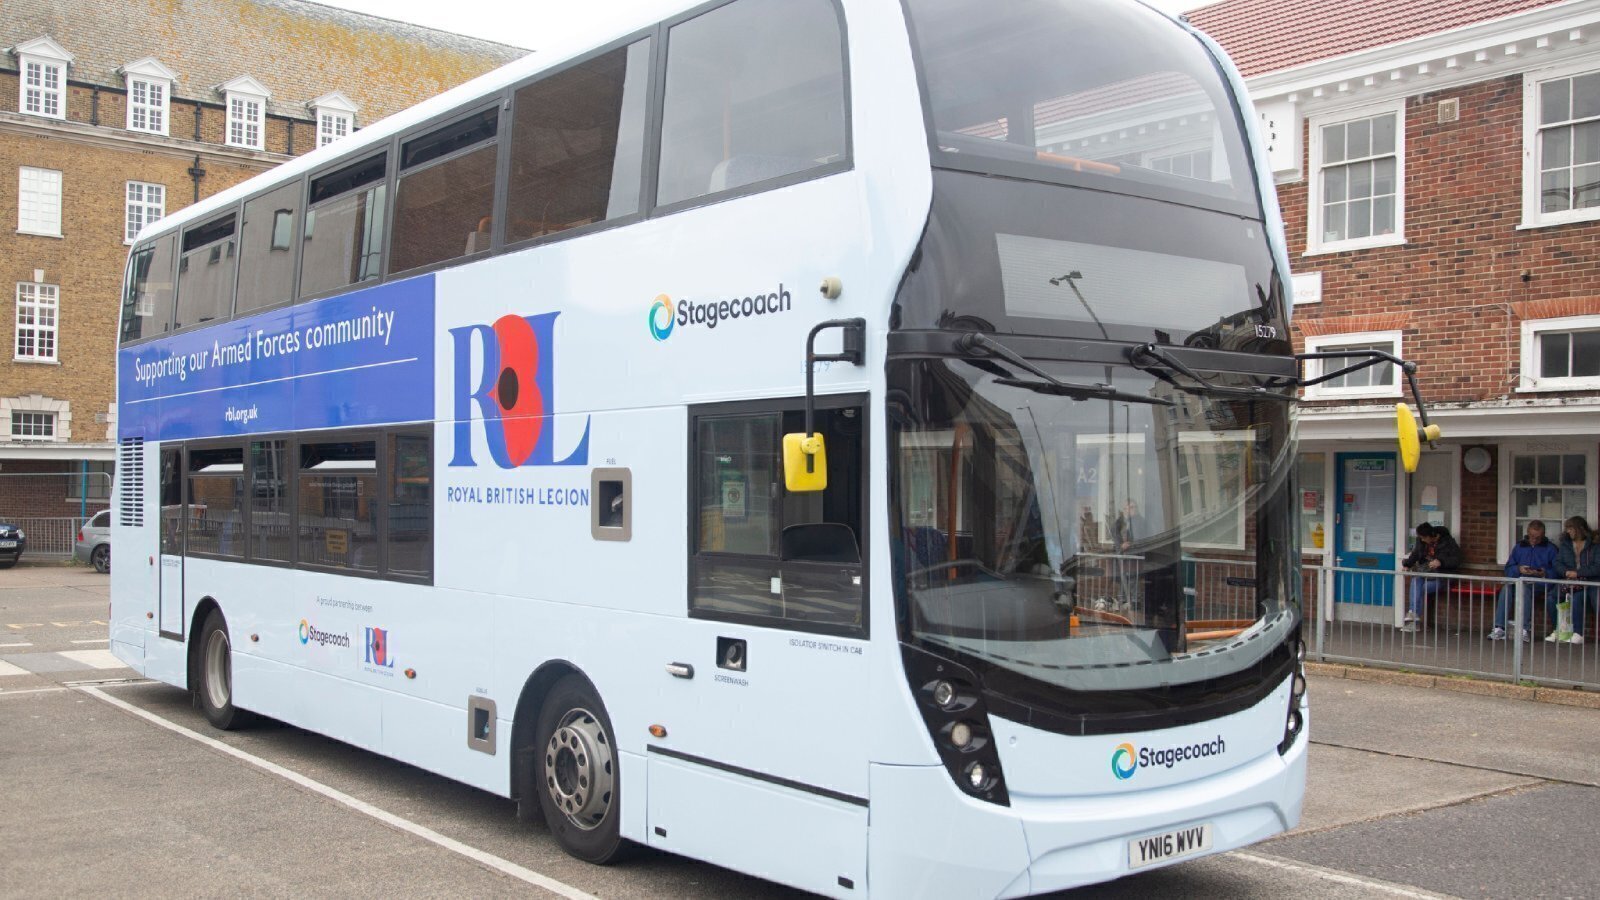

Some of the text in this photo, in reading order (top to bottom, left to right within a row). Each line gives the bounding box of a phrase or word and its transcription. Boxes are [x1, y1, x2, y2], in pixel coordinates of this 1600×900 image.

[677, 283, 791, 329] Stagecoach
[135, 306, 394, 387] Supporting our Armed Forces community
[225, 403, 258, 424] rbl.org.uk
[448, 487, 589, 506] ROYAL BRITISH LEGION
[309, 625, 350, 648] Stagecoach
[714, 674, 749, 687] SCREENWASH
[1138, 734, 1226, 769] Stagecoach
[1138, 826, 1204, 861] YN16 WVV
